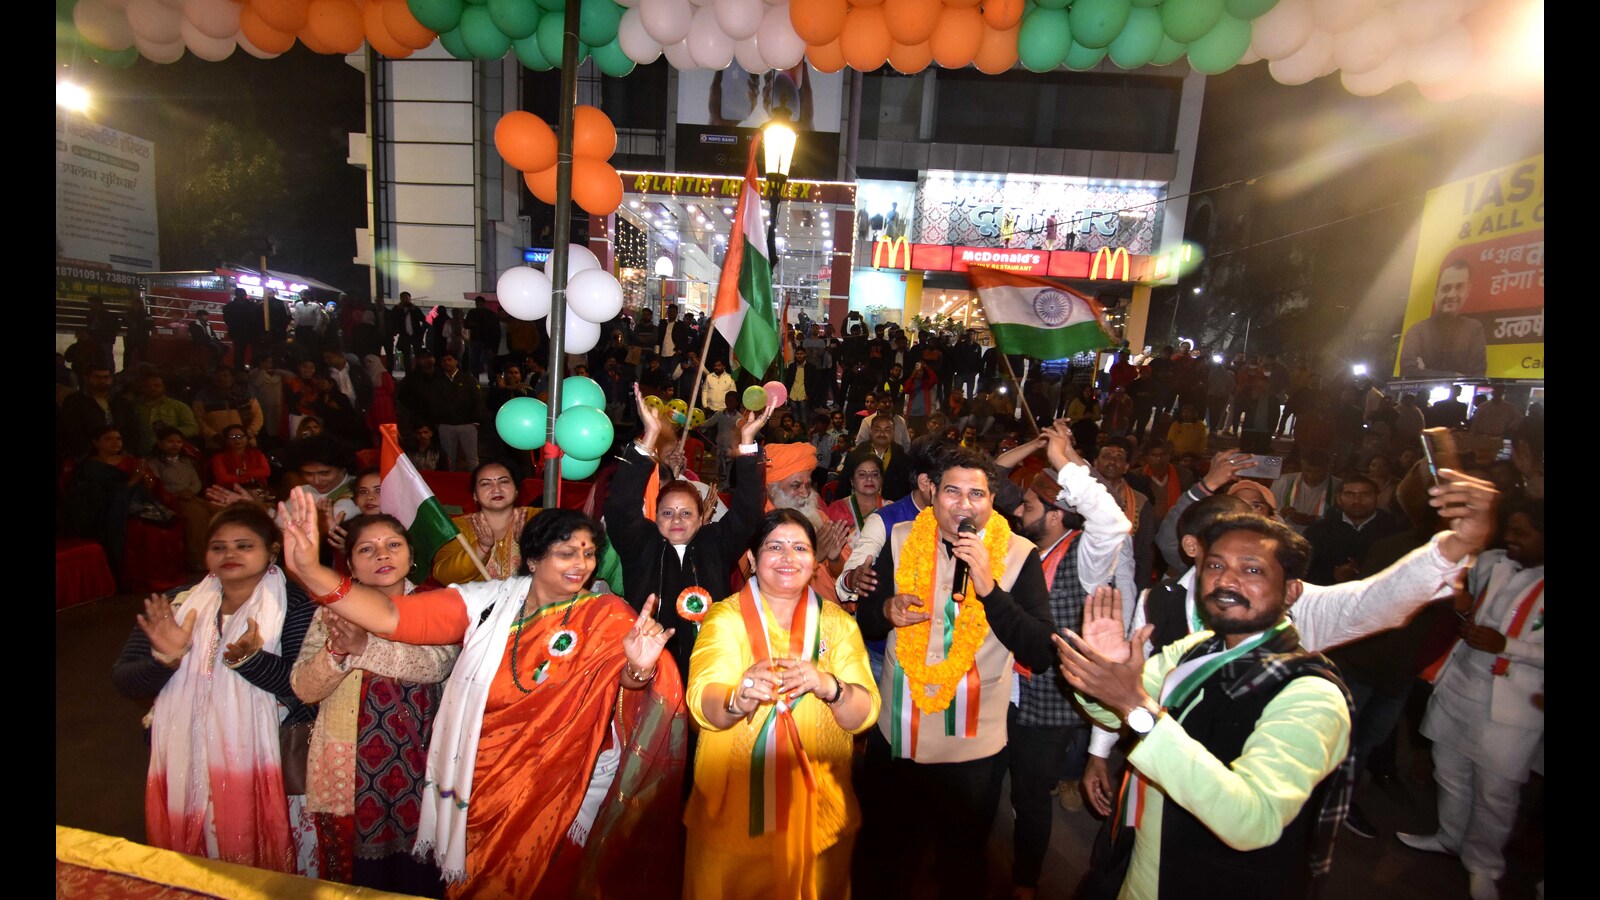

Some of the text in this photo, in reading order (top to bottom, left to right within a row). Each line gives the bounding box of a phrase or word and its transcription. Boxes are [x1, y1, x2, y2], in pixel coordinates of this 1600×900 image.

[633, 175, 713, 193] ATLANTIS
[1462, 164, 1537, 216] IAS
[1458, 220, 1472, 240] &
[1478, 208, 1524, 236] ALL
[962, 250, 1040, 264] McDonald's
[1491, 268, 1536, 295] होगा
[1521, 356, 1544, 369] Ca
